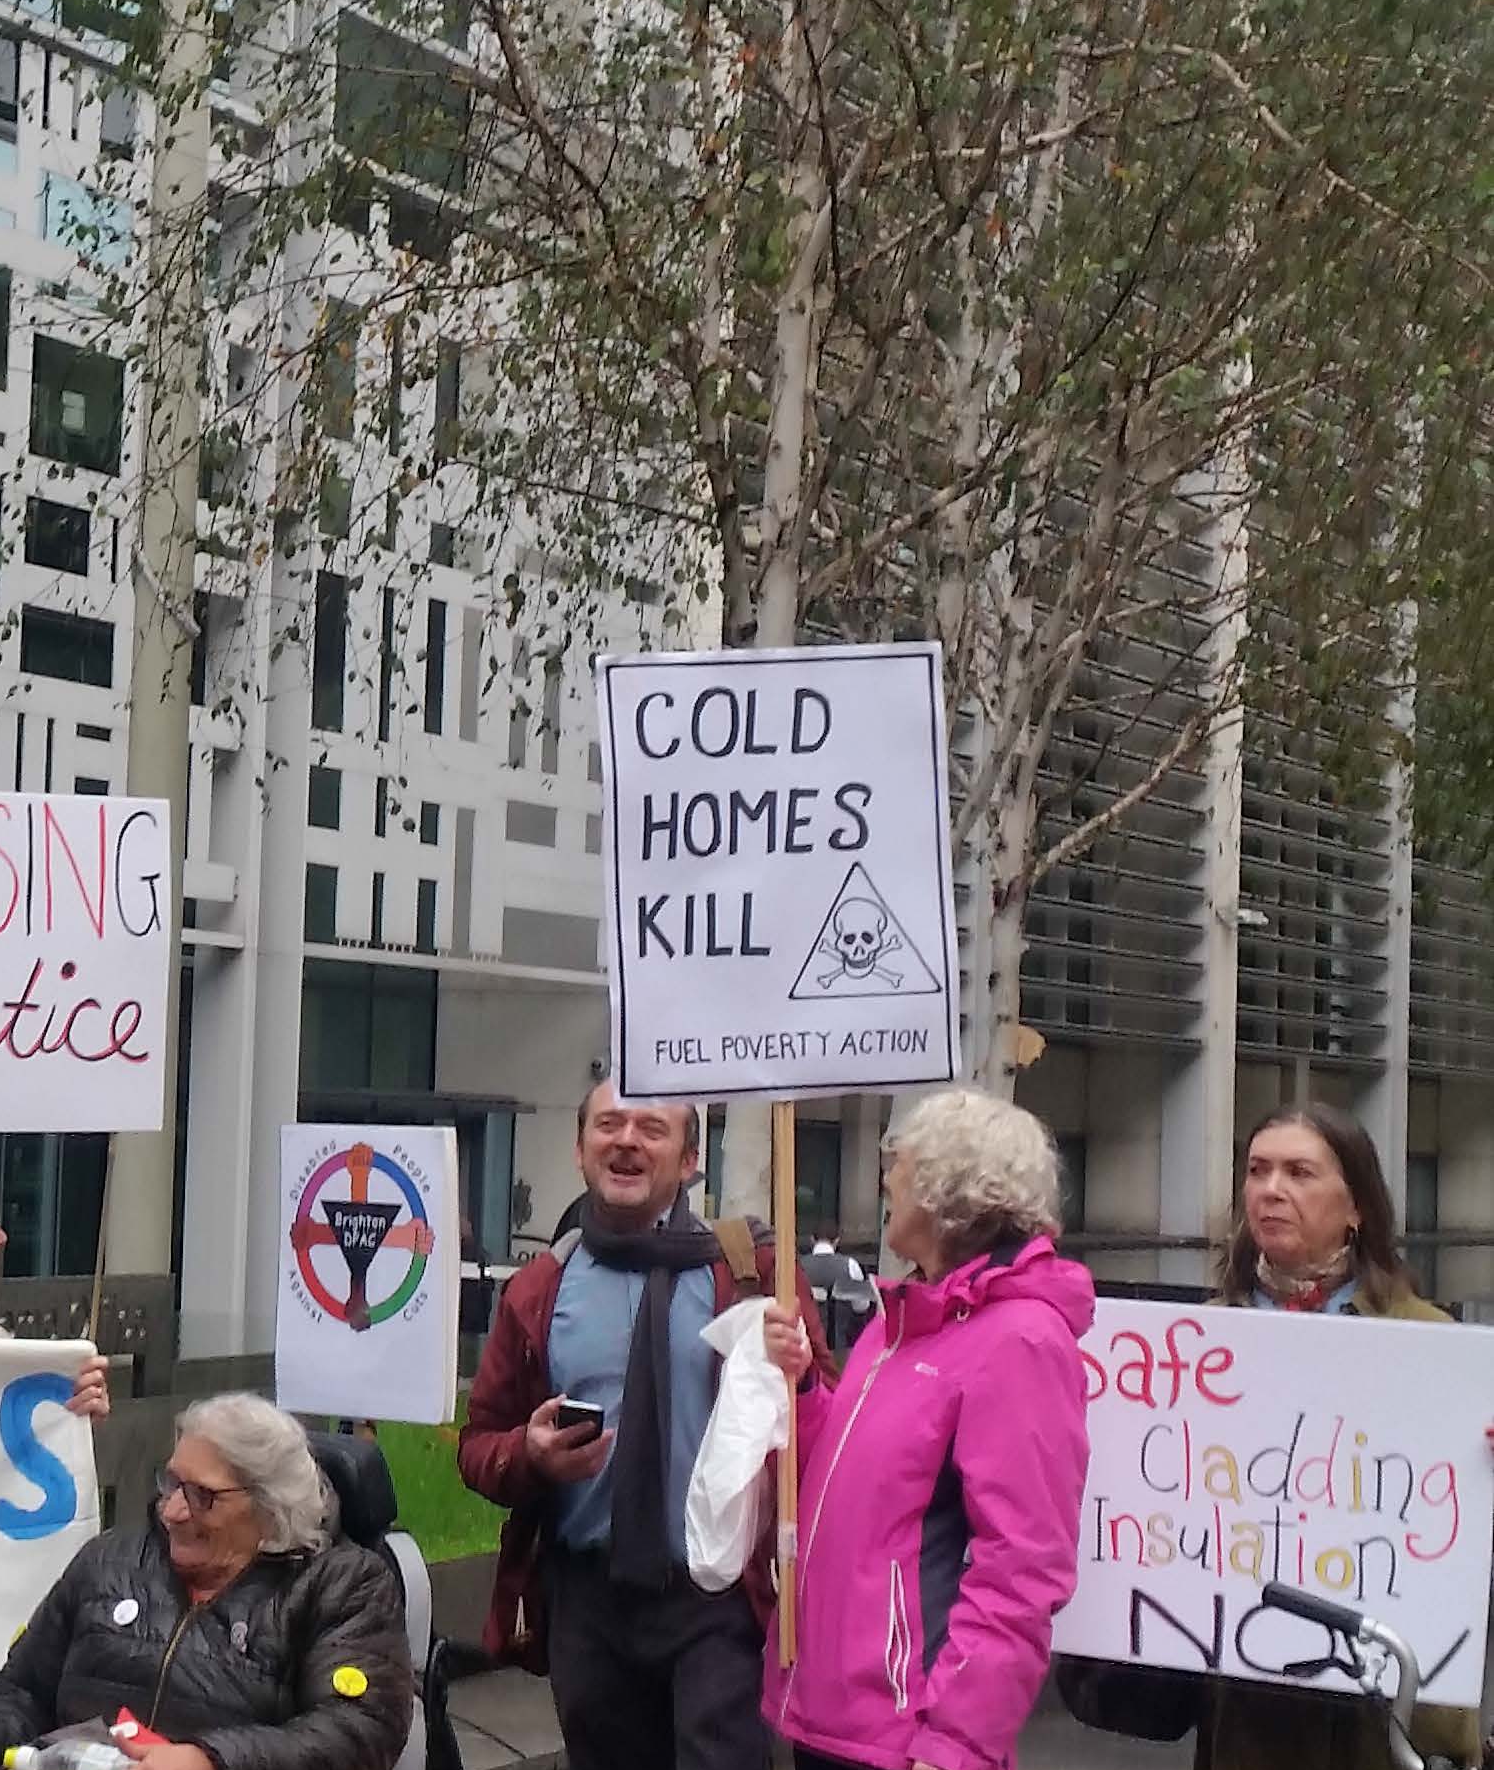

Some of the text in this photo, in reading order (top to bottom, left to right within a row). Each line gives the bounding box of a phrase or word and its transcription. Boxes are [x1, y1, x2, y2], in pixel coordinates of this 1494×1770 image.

[635, 687, 832, 759] COLD
[642, 782, 872, 860] HOMES
[637, 892, 771, 958] KILL
[656, 1029, 928, 1065] FUEL POVERTY ACTION
[334, 1211, 386, 1232] Brighton
[1141, 1412, 1460, 1561] Cladding
[1091, 1497, 1400, 1601] Insulation
